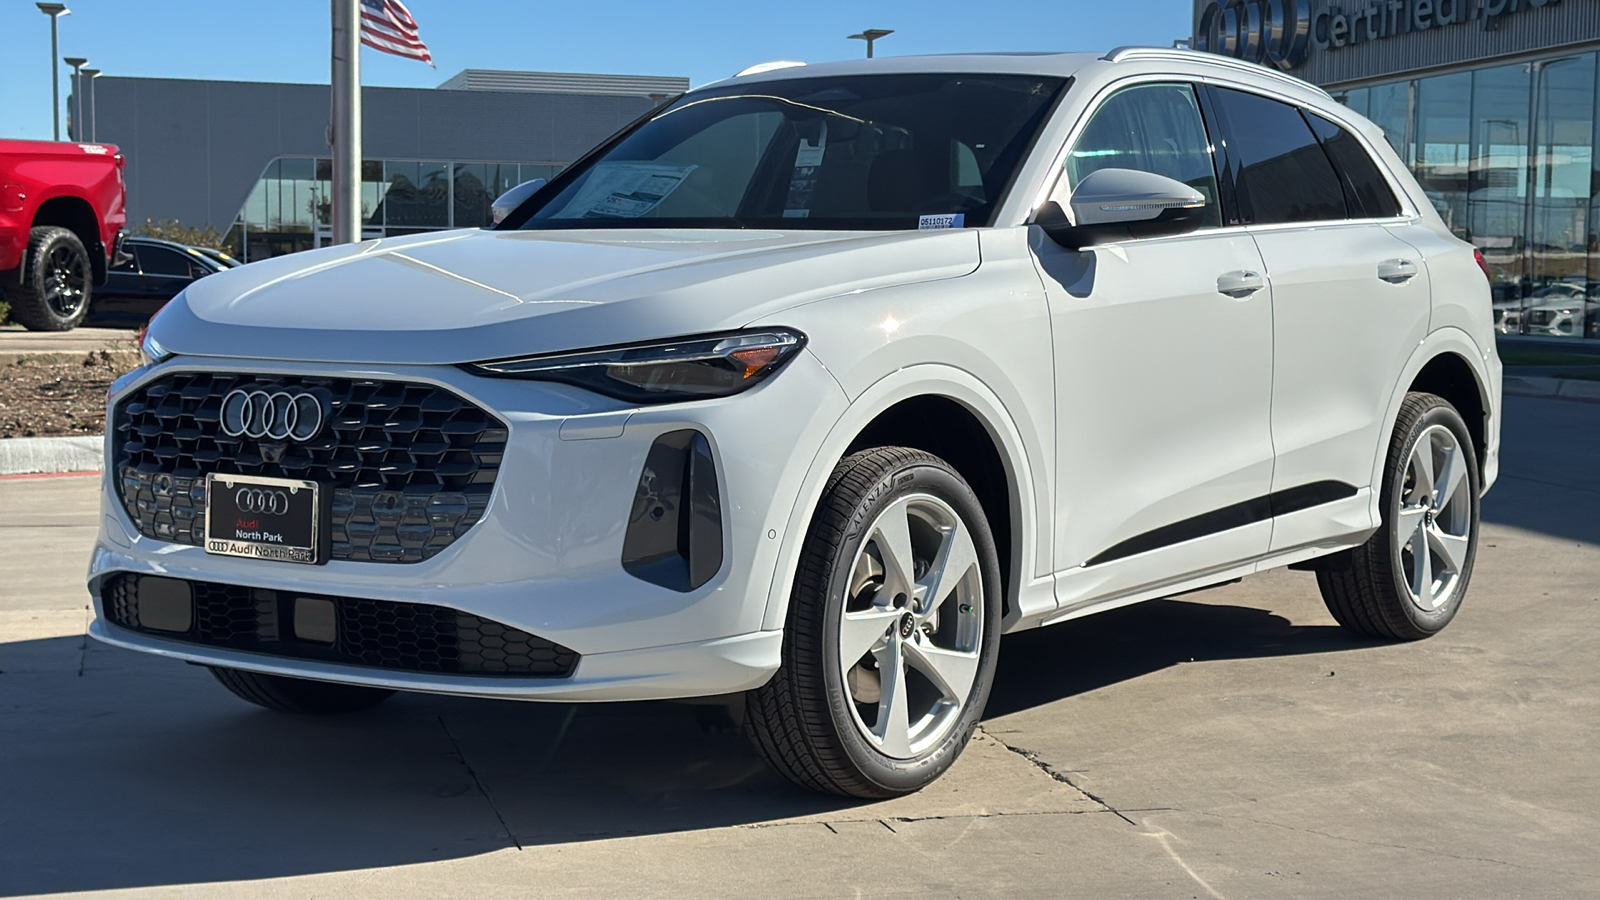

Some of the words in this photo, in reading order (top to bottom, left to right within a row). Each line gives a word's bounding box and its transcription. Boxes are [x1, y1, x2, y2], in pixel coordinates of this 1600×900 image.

[853, 482, 889, 530] ALENZA
[236, 519, 259, 529] Audi
[236, 529, 261, 540] North
[263, 532, 283, 543] Park
[229, 543, 253, 555] Audi
[255, 546, 286, 559] North
[288, 549, 312, 562] Park
